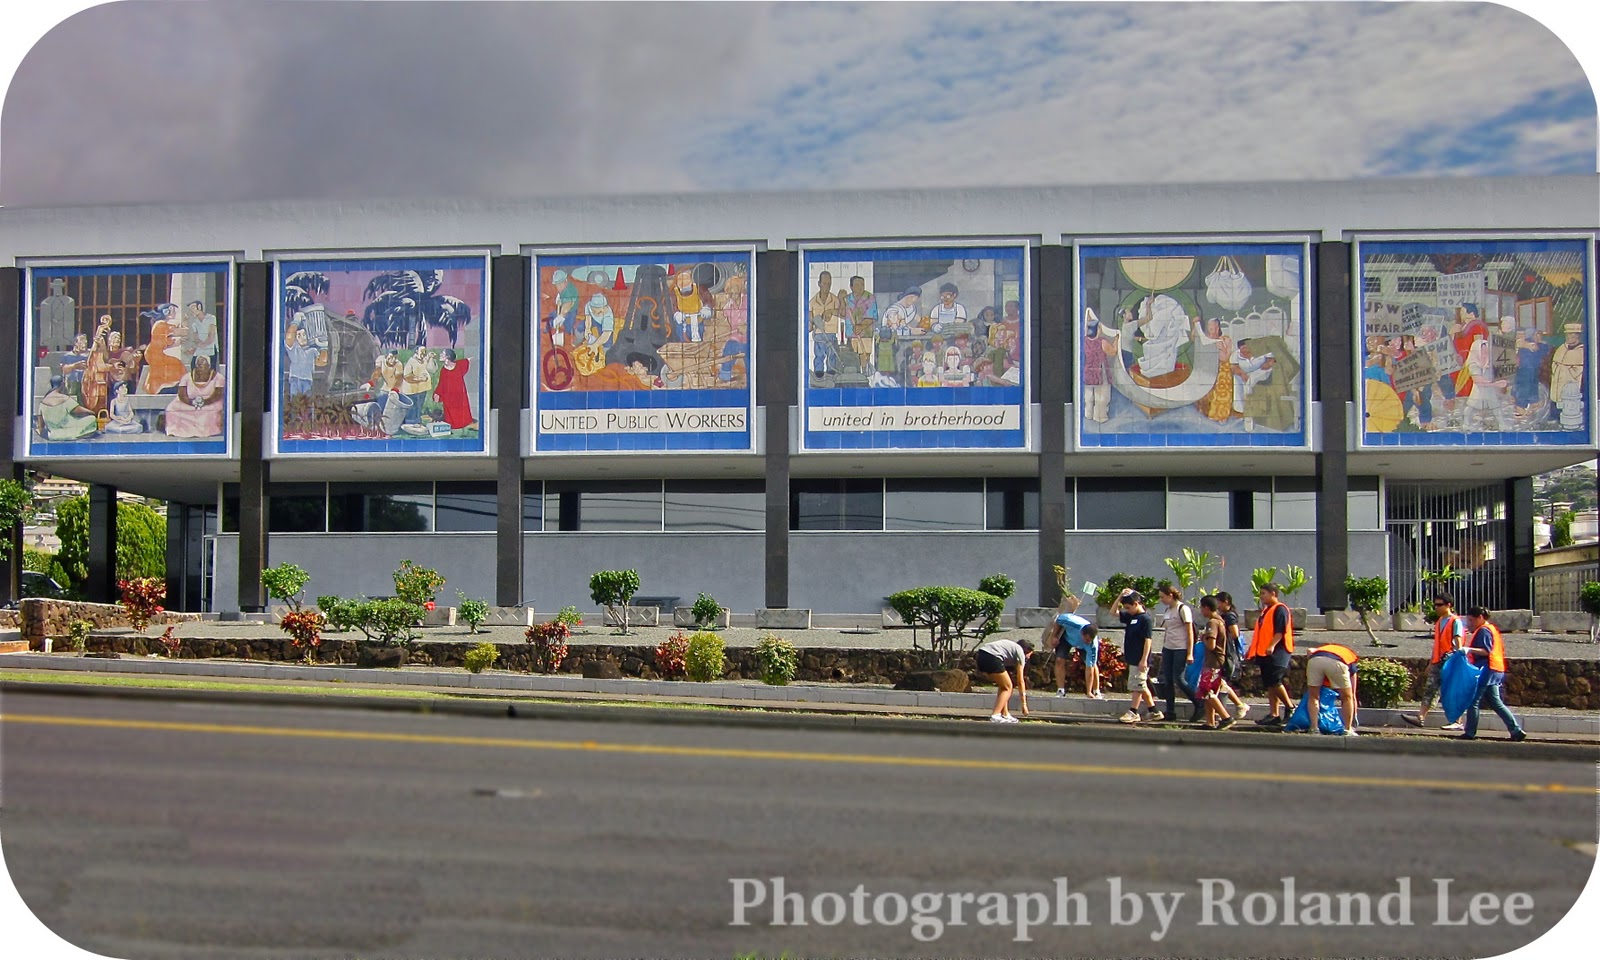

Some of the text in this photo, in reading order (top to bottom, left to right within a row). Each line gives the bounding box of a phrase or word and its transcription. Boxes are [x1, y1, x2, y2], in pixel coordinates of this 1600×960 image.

[1496, 348, 1511, 364] 4
[541, 412, 745, 430] UNITED PUBLIC WORKERS
[823, 410, 1006, 427] united in brotherhood
